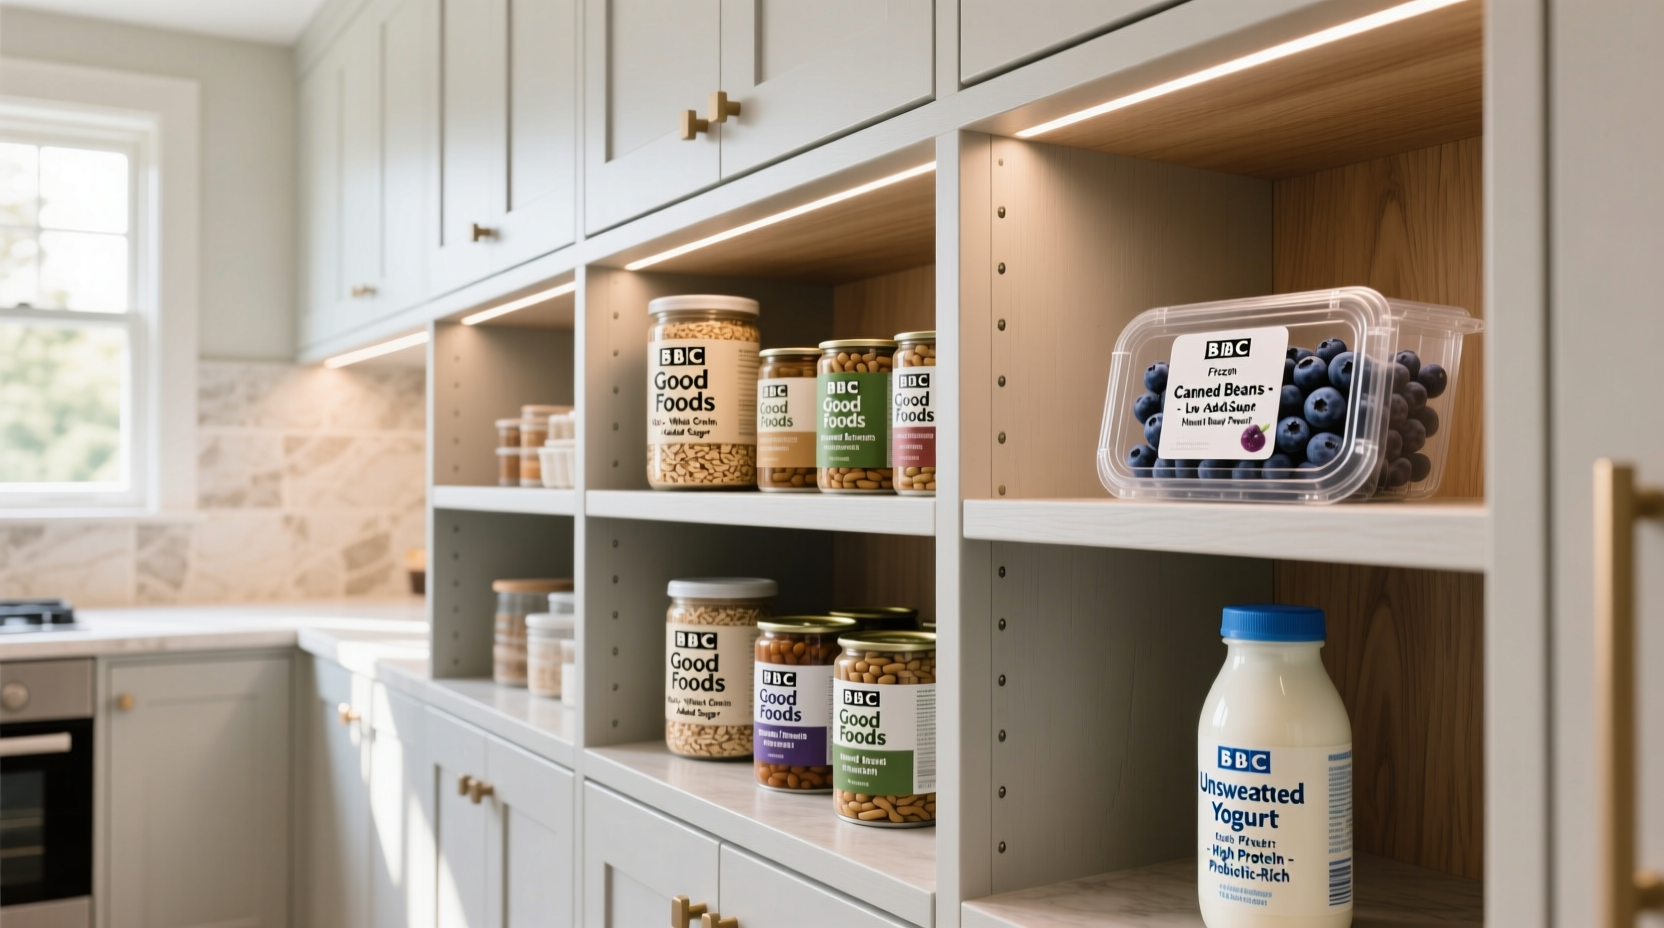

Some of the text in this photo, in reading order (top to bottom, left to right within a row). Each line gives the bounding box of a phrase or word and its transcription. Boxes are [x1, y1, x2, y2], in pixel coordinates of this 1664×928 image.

[661, 348, 704, 365] BBC
[1207, 340, 1249, 358] BBC
[654, 369, 708, 390] Good
[1174, 383, 1221, 399] Canned
[1224, 382, 1265, 397] Beans
[656, 392, 716, 412] Foods
[822, 396, 861, 412] Good
[823, 413, 866, 428] Foods
[896, 408, 935, 422] Foods
[676, 631, 716, 649] BBC
[670, 652, 719, 672] Good
[672, 672, 726, 692] Foods
[760, 688, 797, 706] Good
[760, 705, 802, 722] Foods
[840, 709, 880, 728] Good
[840, 726, 886, 746] Foods
[1220, 748, 1268, 772] BBC
[1212, 802, 1280, 832] Yogurt
[1238, 849, 1284, 865] Protein
